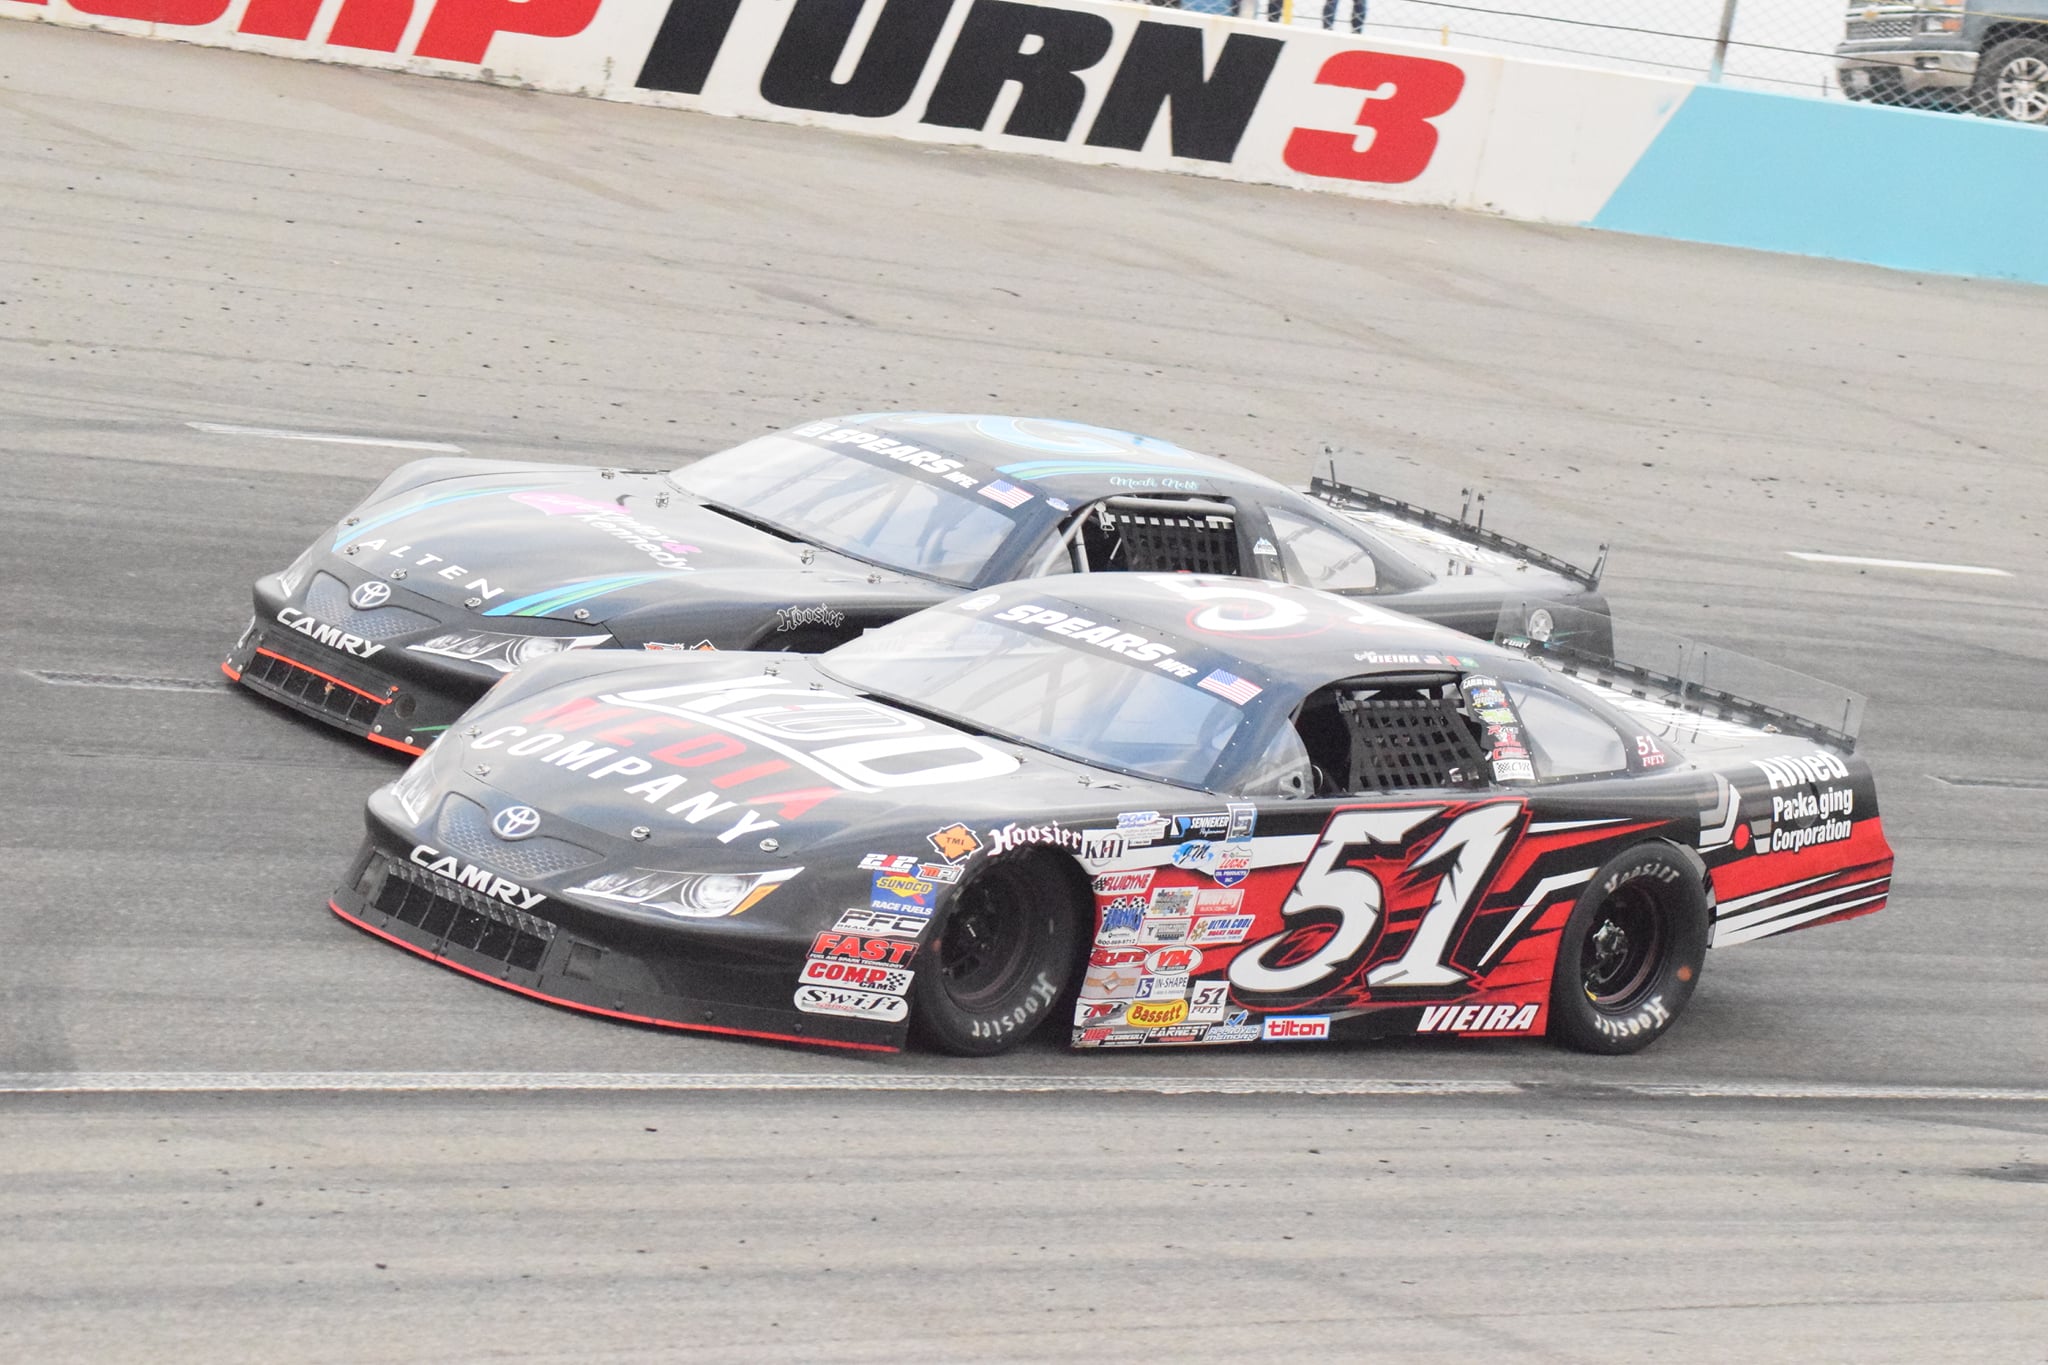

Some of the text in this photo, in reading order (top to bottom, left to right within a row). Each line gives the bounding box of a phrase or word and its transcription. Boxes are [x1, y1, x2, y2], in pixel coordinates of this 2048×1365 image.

[634, 0, 1286, 164] TURN
[1284, 49, 1465, 185] 3
[818, 426, 965, 476] SPEARS
[358, 538, 505, 600] ALTEN
[777, 603, 845, 632] Hoosier
[276, 607, 386, 658] CAMRY
[993, 604, 1199, 678] SPEARS MFG
[1368, 654, 1420, 664] VIEIRA
[1636, 736, 1661, 756] 51
[520, 698, 842, 821] MEDIA
[1750, 750, 1849, 790] Allied
[470, 725, 780, 844] COMPANY
[1772, 786, 1853, 822] Packaging
[1190, 816, 1230, 829] SENNEKER
[946, 836, 965, 846] TMI
[987, 820, 1082, 856] Hoosier
[1772, 818, 1852, 853] Corporation
[1084, 840, 1128, 860] KHI
[1218, 857, 1250, 870] LUCAS
[410, 844, 547, 910] CAMRY
[878, 877, 931, 895] SUNOCO
[1104, 873, 1151, 892] FLUIDYNE
[871, 900, 934, 916] RACE FUELS
[1228, 803, 1523, 992] 51
[812, 932, 914, 964] FAST
[807, 962, 888, 984] COMP
[1156, 976, 1188, 989] IN-SHAPE
[859, 981, 898, 992] CAMS
[1193, 987, 1226, 1006] 51
[1131, 1004, 1183, 1023] Bassett
[1416, 1004, 1539, 1032] VIEIRA
[1149, 1026, 1207, 1038] EARNEST
[1268, 1020, 1326, 1037] tilton
